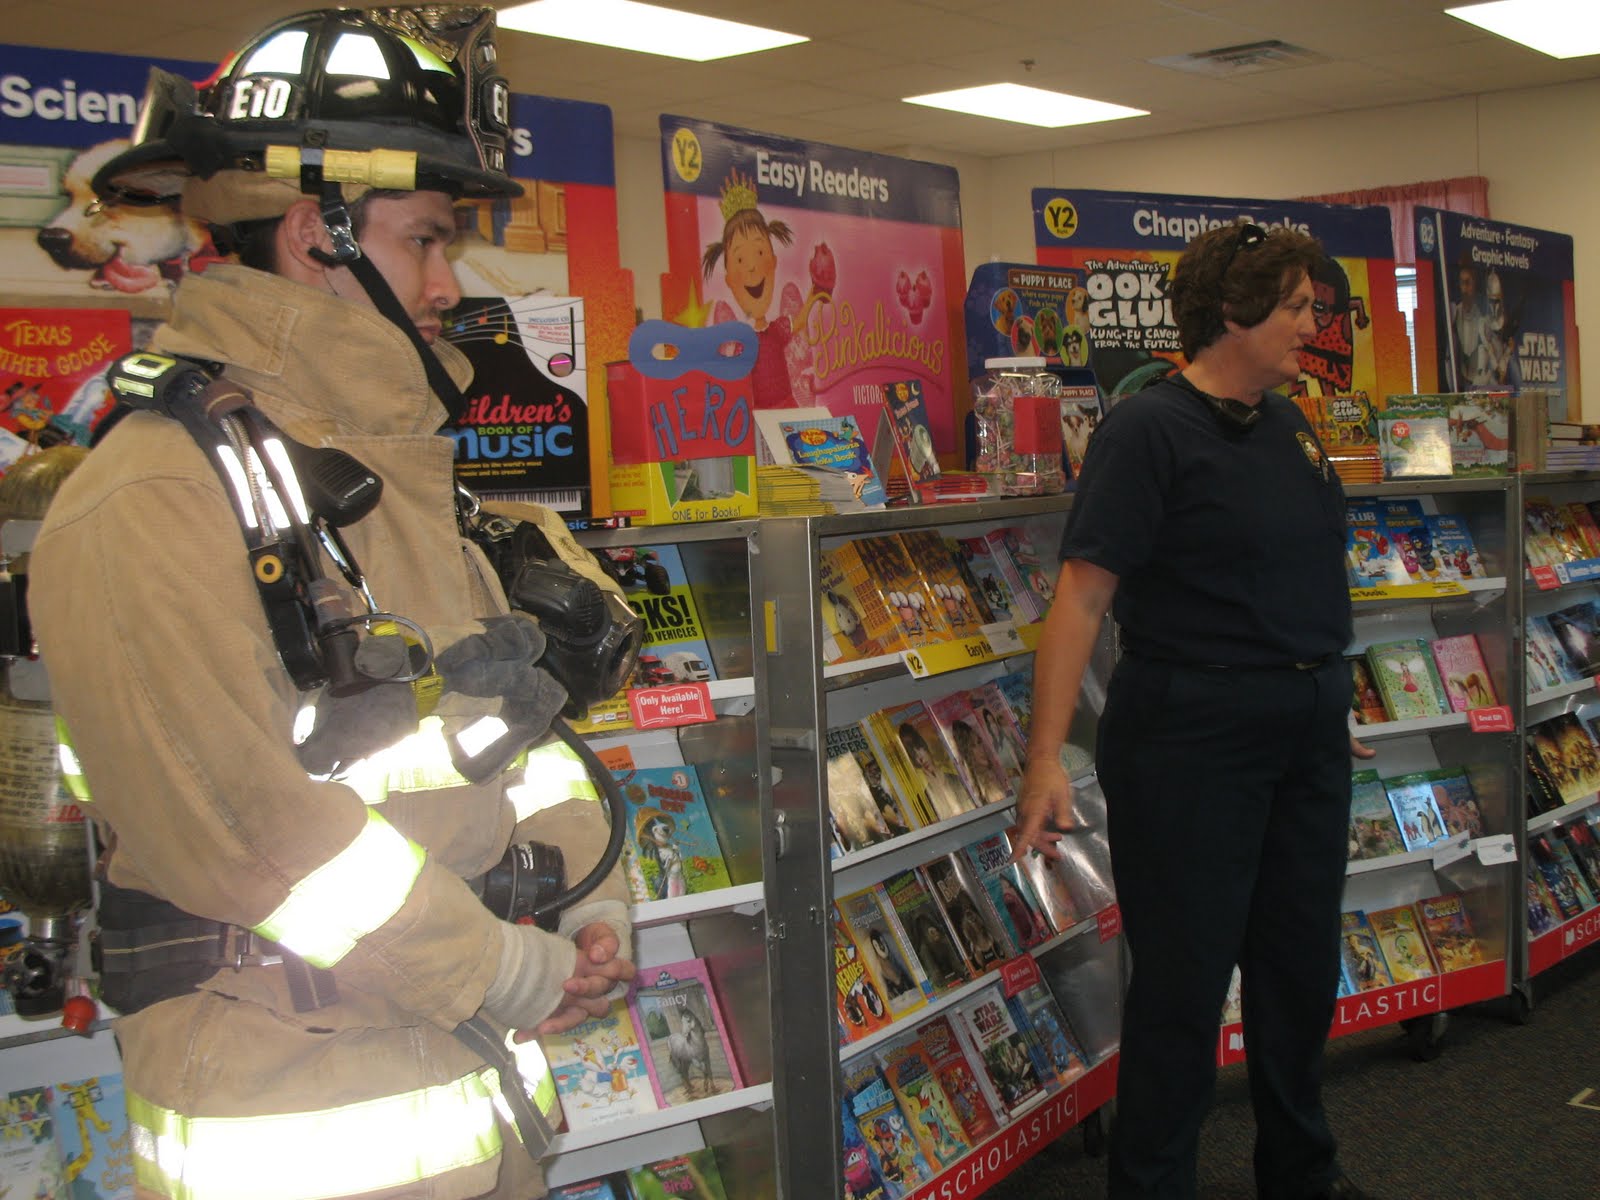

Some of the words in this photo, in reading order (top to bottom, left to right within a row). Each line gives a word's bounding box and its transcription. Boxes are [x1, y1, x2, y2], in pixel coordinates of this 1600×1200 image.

[0, 75, 145, 125] Scien
[230, 79, 292, 119] E10
[676, 137, 700, 169] Y2
[756, 151, 806, 197] Easy
[809, 159, 889, 203] Readers
[1047, 206, 1075, 228] Y2
[1460, 221, 1501, 244] Adventure
[1505, 228, 1535, 251] Fantasy
[1084, 260, 1103, 271] The
[1472, 246, 1503, 267] Graphic
[1504, 251, 1530, 270] Novels
[1020, 274, 1046, 288] PUPPY
[1048, 276, 1073, 290] PLACE
[1086, 272, 1164, 300] OOK
[5, 320, 73, 347] TEXAS
[806, 291, 944, 379] Pinkalicious
[1089, 328, 1142, 340] KUNG-FU
[1094, 340, 1121, 349] FROM
[1519, 332, 1559, 358] STAR
[0, 348, 53, 378] THER
[56, 334, 117, 376] GOOSE
[1520, 359, 1560, 382] WARS
[478, 426, 513, 436] BOOK
[517, 425, 533, 434] OF
[650, 381, 750, 459] HERO
[672, 509, 692, 521] ONE
[695, 508, 708, 520] for
[655, 626, 698, 641] VEHICLES
[965, 642, 984, 658] Easy
[907, 654, 923, 671] Y2
[640, 696, 659, 706] Only
[661, 691, 699, 703] Available
[660, 705, 684, 716] Here!
[1338, 984, 1436, 1025] LASTIC
[941, 1094, 1074, 1200] SCHOLASTIC
